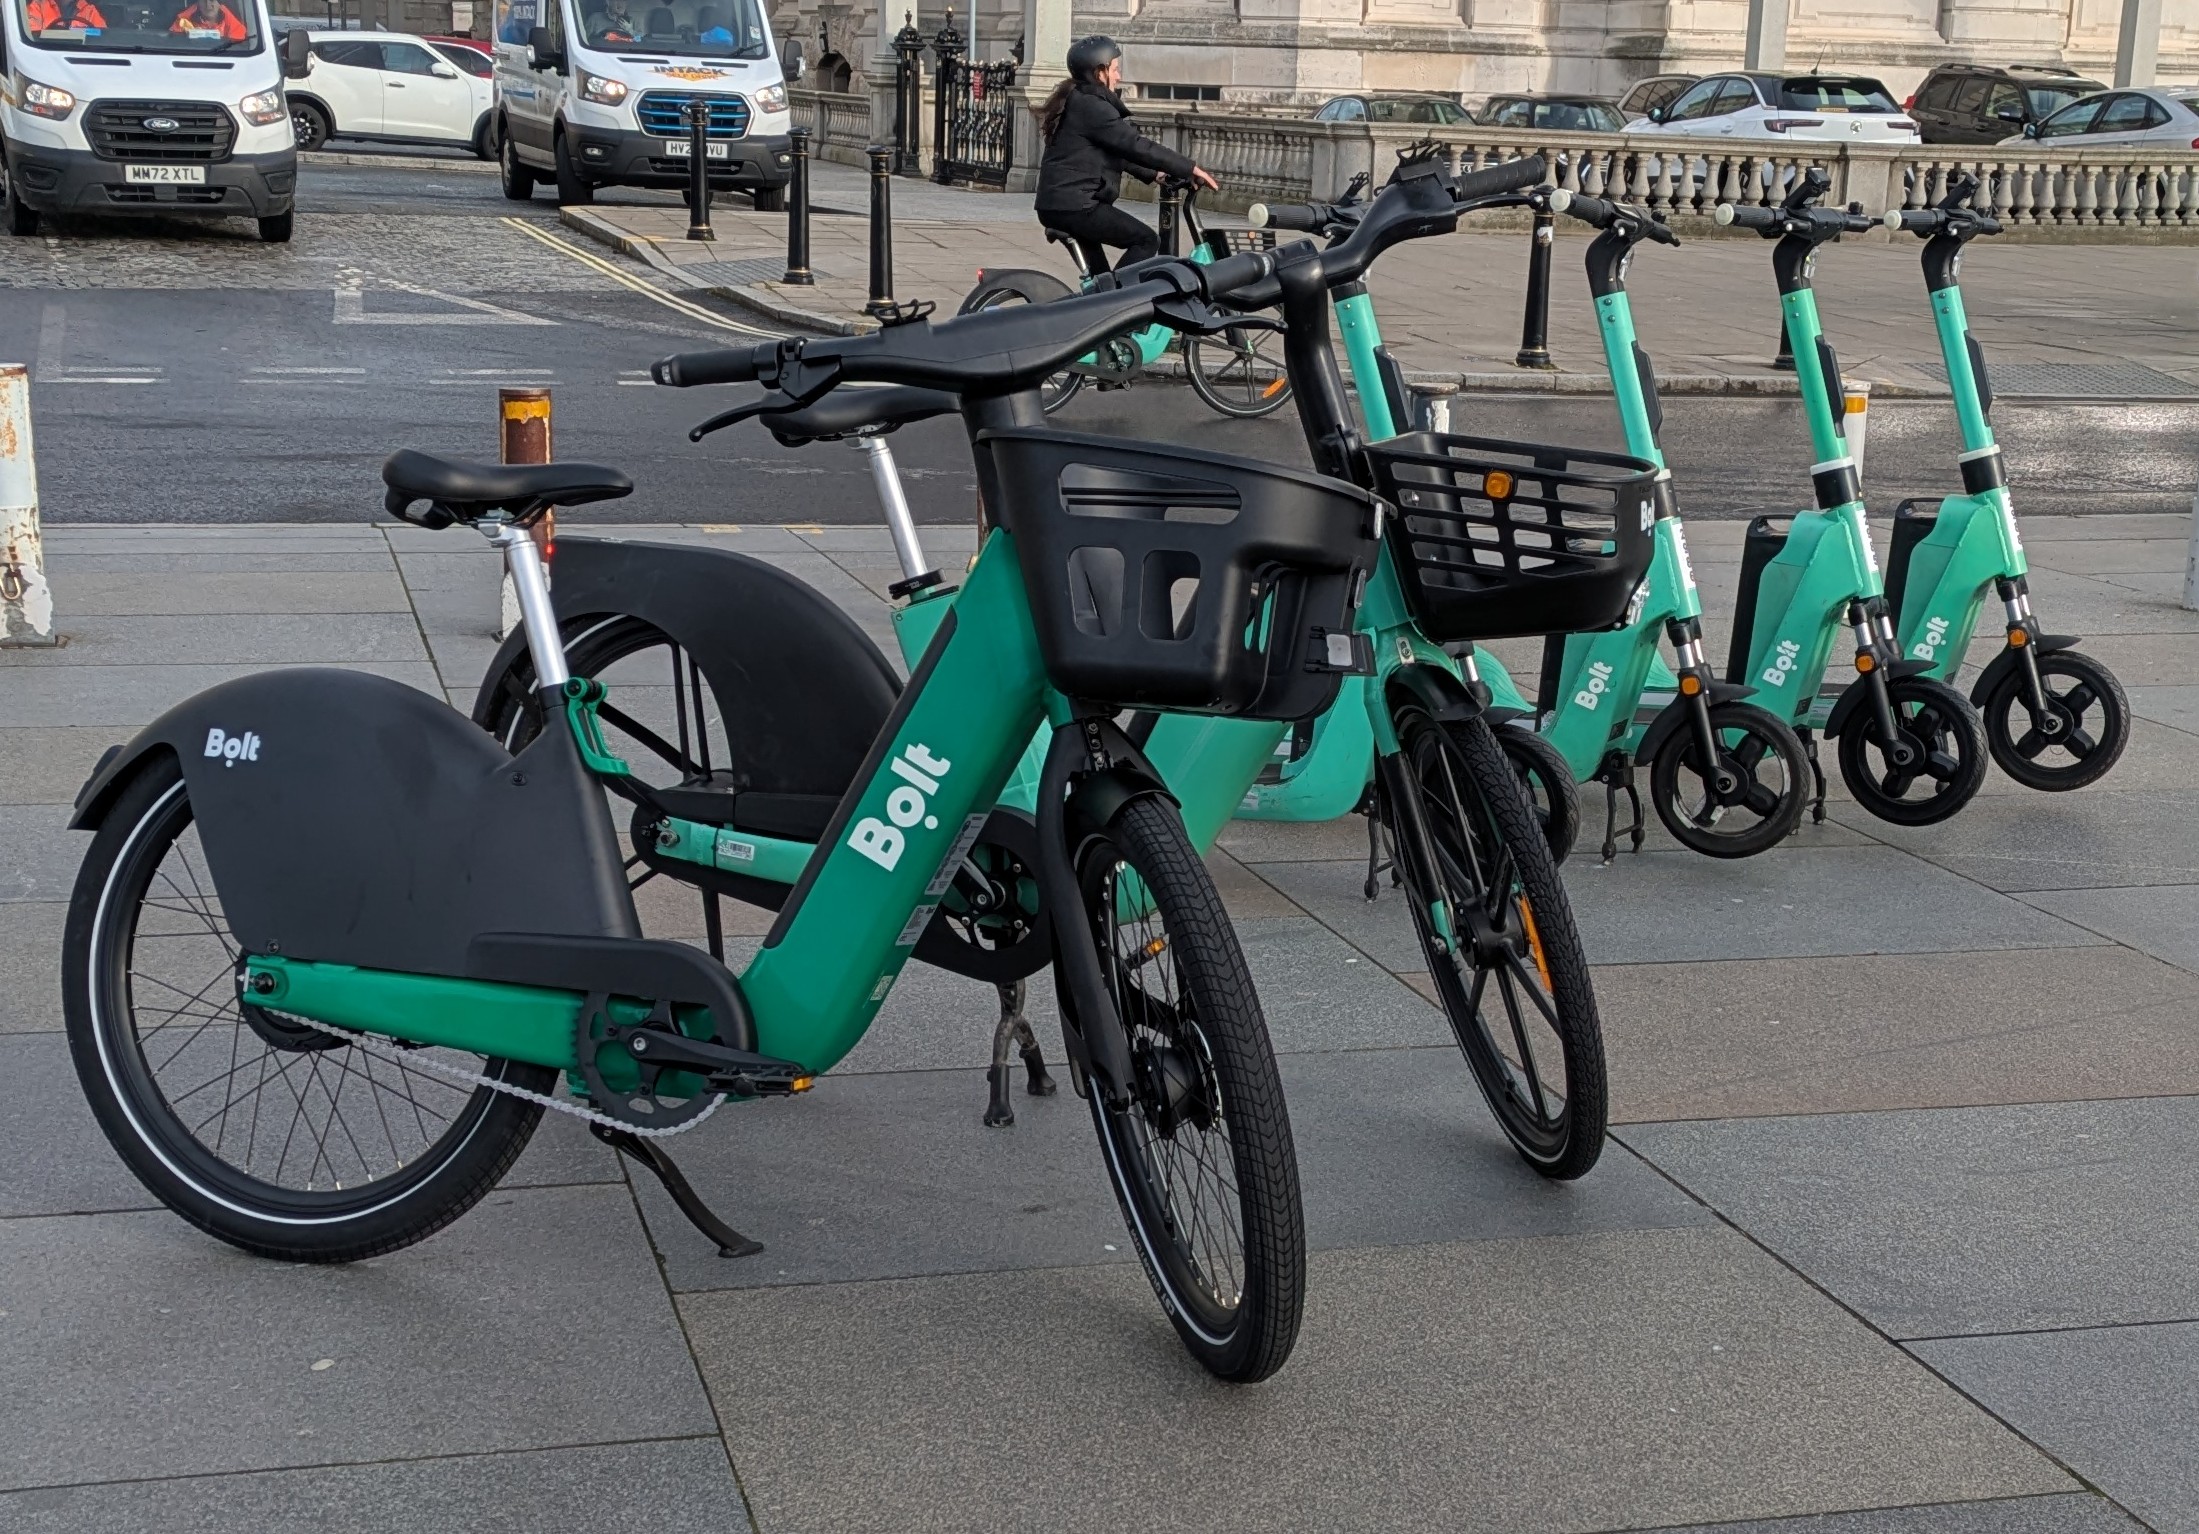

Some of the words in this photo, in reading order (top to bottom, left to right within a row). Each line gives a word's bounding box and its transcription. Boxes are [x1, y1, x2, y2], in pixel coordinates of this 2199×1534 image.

[653, 65, 727, 76] INTACK
[671, 143, 692, 155] HV2
[704, 145, 723, 155] VU
[132, 166, 169, 180] MM72
[172, 167, 200, 181] XTL
[1640, 498, 1655, 537] Bol
[1912, 616, 1950, 661] Bolt
[1762, 640, 1800, 687] Bolt
[1574, 661, 1613, 711] Bolt
[204, 727, 261, 768] Bolt
[846, 742, 951, 873] Bolt
